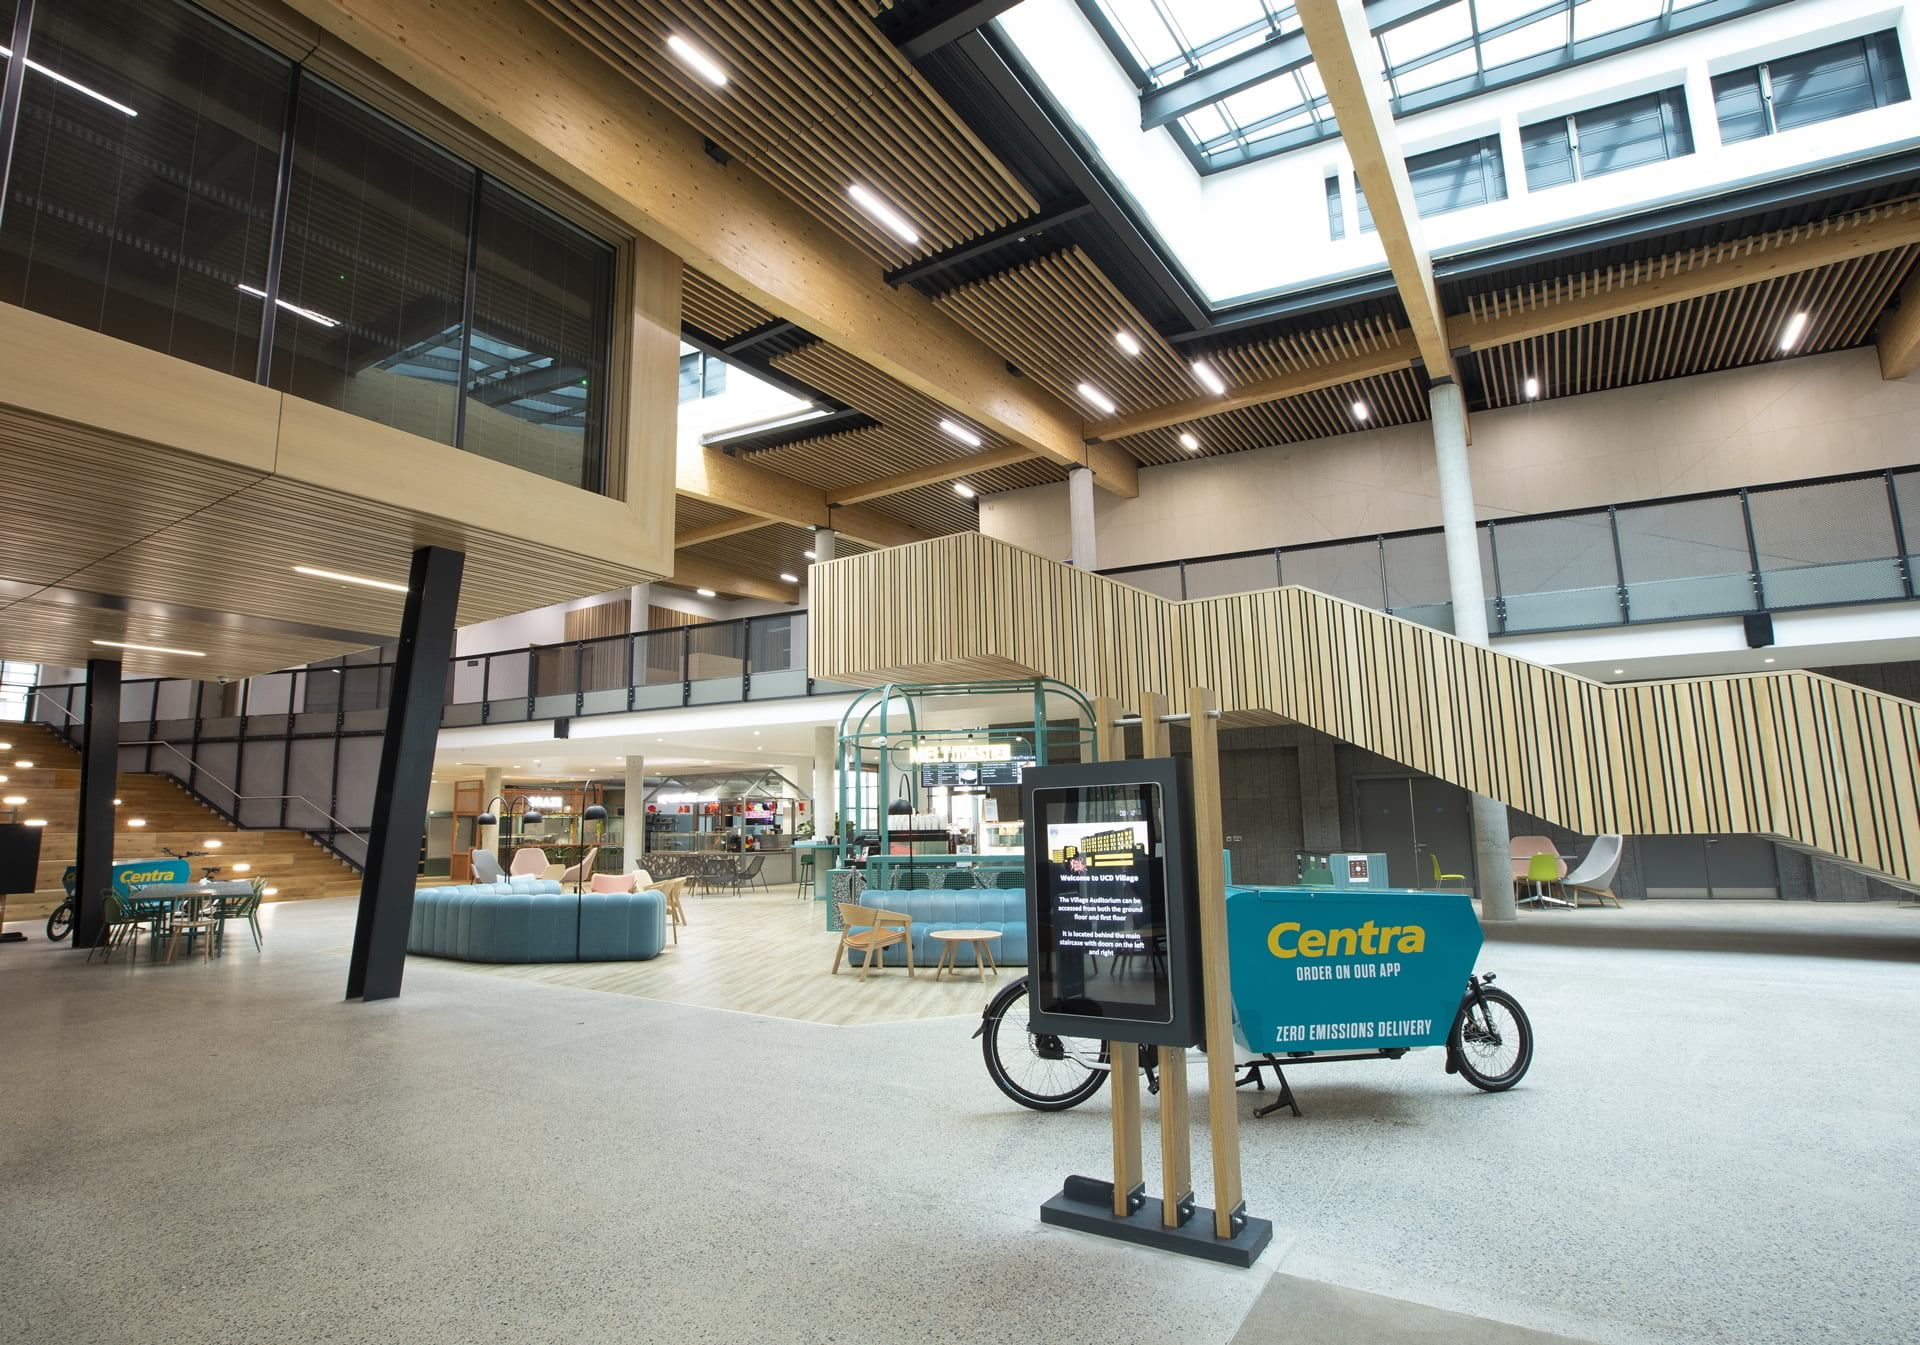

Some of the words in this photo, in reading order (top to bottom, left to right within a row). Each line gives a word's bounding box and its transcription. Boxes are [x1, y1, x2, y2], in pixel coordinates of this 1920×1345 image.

[120, 870, 175, 884] Centra
[1100, 874, 1114, 882] UCD
[1115, 874, 1139, 883] Village
[1122, 906, 1143, 914] ground
[1267, 920, 1425, 958] Centra
[1296, 965, 1332, 981] ORDER
[1335, 964, 1350, 979] ON
[1354, 963, 1376, 978] OUR
[1380, 962, 1401, 977] APP
[1276, 1025, 1305, 1042] ZERO
[1309, 1022, 1374, 1040] EMISSIONS
[1378, 1019, 1432, 1037] DELIVERY
